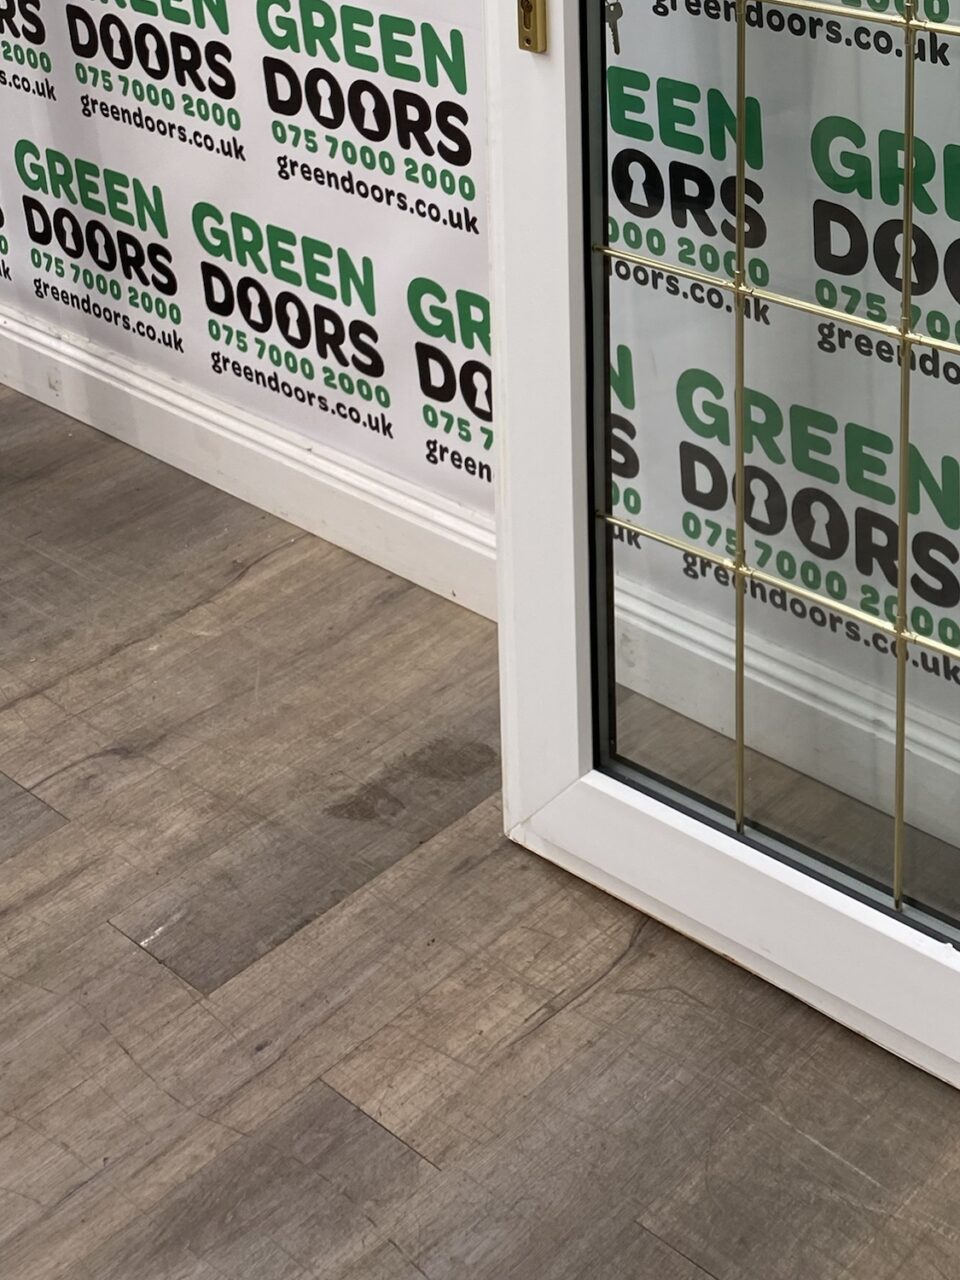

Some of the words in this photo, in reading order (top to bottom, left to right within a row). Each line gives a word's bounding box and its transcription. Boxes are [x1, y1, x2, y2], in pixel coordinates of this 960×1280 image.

[1, 42, 51, 71] 2000
[66, 4, 235, 99] DOORS
[75, 64, 112, 90] 075
[119, 76, 174, 110] 7000
[182, 95, 240, 129] 2000
[81, 95, 245, 161] greendoors.co.uk
[263, 56, 471, 166] DOORS
[605, 66, 764, 170] EEN
[15, 139, 168, 238] GREEN
[272, 121, 317, 152] 075
[325, 135, 395, 175] 7000
[404, 158, 475, 201] 2000
[277, 156, 479, 234] greendoors.co.uk
[612, 149, 767, 244] ORS
[23, 195, 177, 301] DOORS
[31, 248, 64, 276] 075
[72, 264, 121, 300] 7000
[129, 288, 181, 324] 2000
[192, 202, 375, 316] GREEN
[34, 279, 183, 353] greendoors.co.uk
[201, 261, 384, 377] DOORS
[816, 278, 886, 323] 075
[208, 319, 247, 352] 075
[256, 338, 314, 379] 7000
[323, 367, 390, 408] 2000
[211, 352, 393, 438] greendoors.co.uk
[423, 405, 471, 442] 075
[676, 368, 960, 531] GREEN
[680, 441, 960, 611] DOORS
[755, 541, 846, 599] 7000
